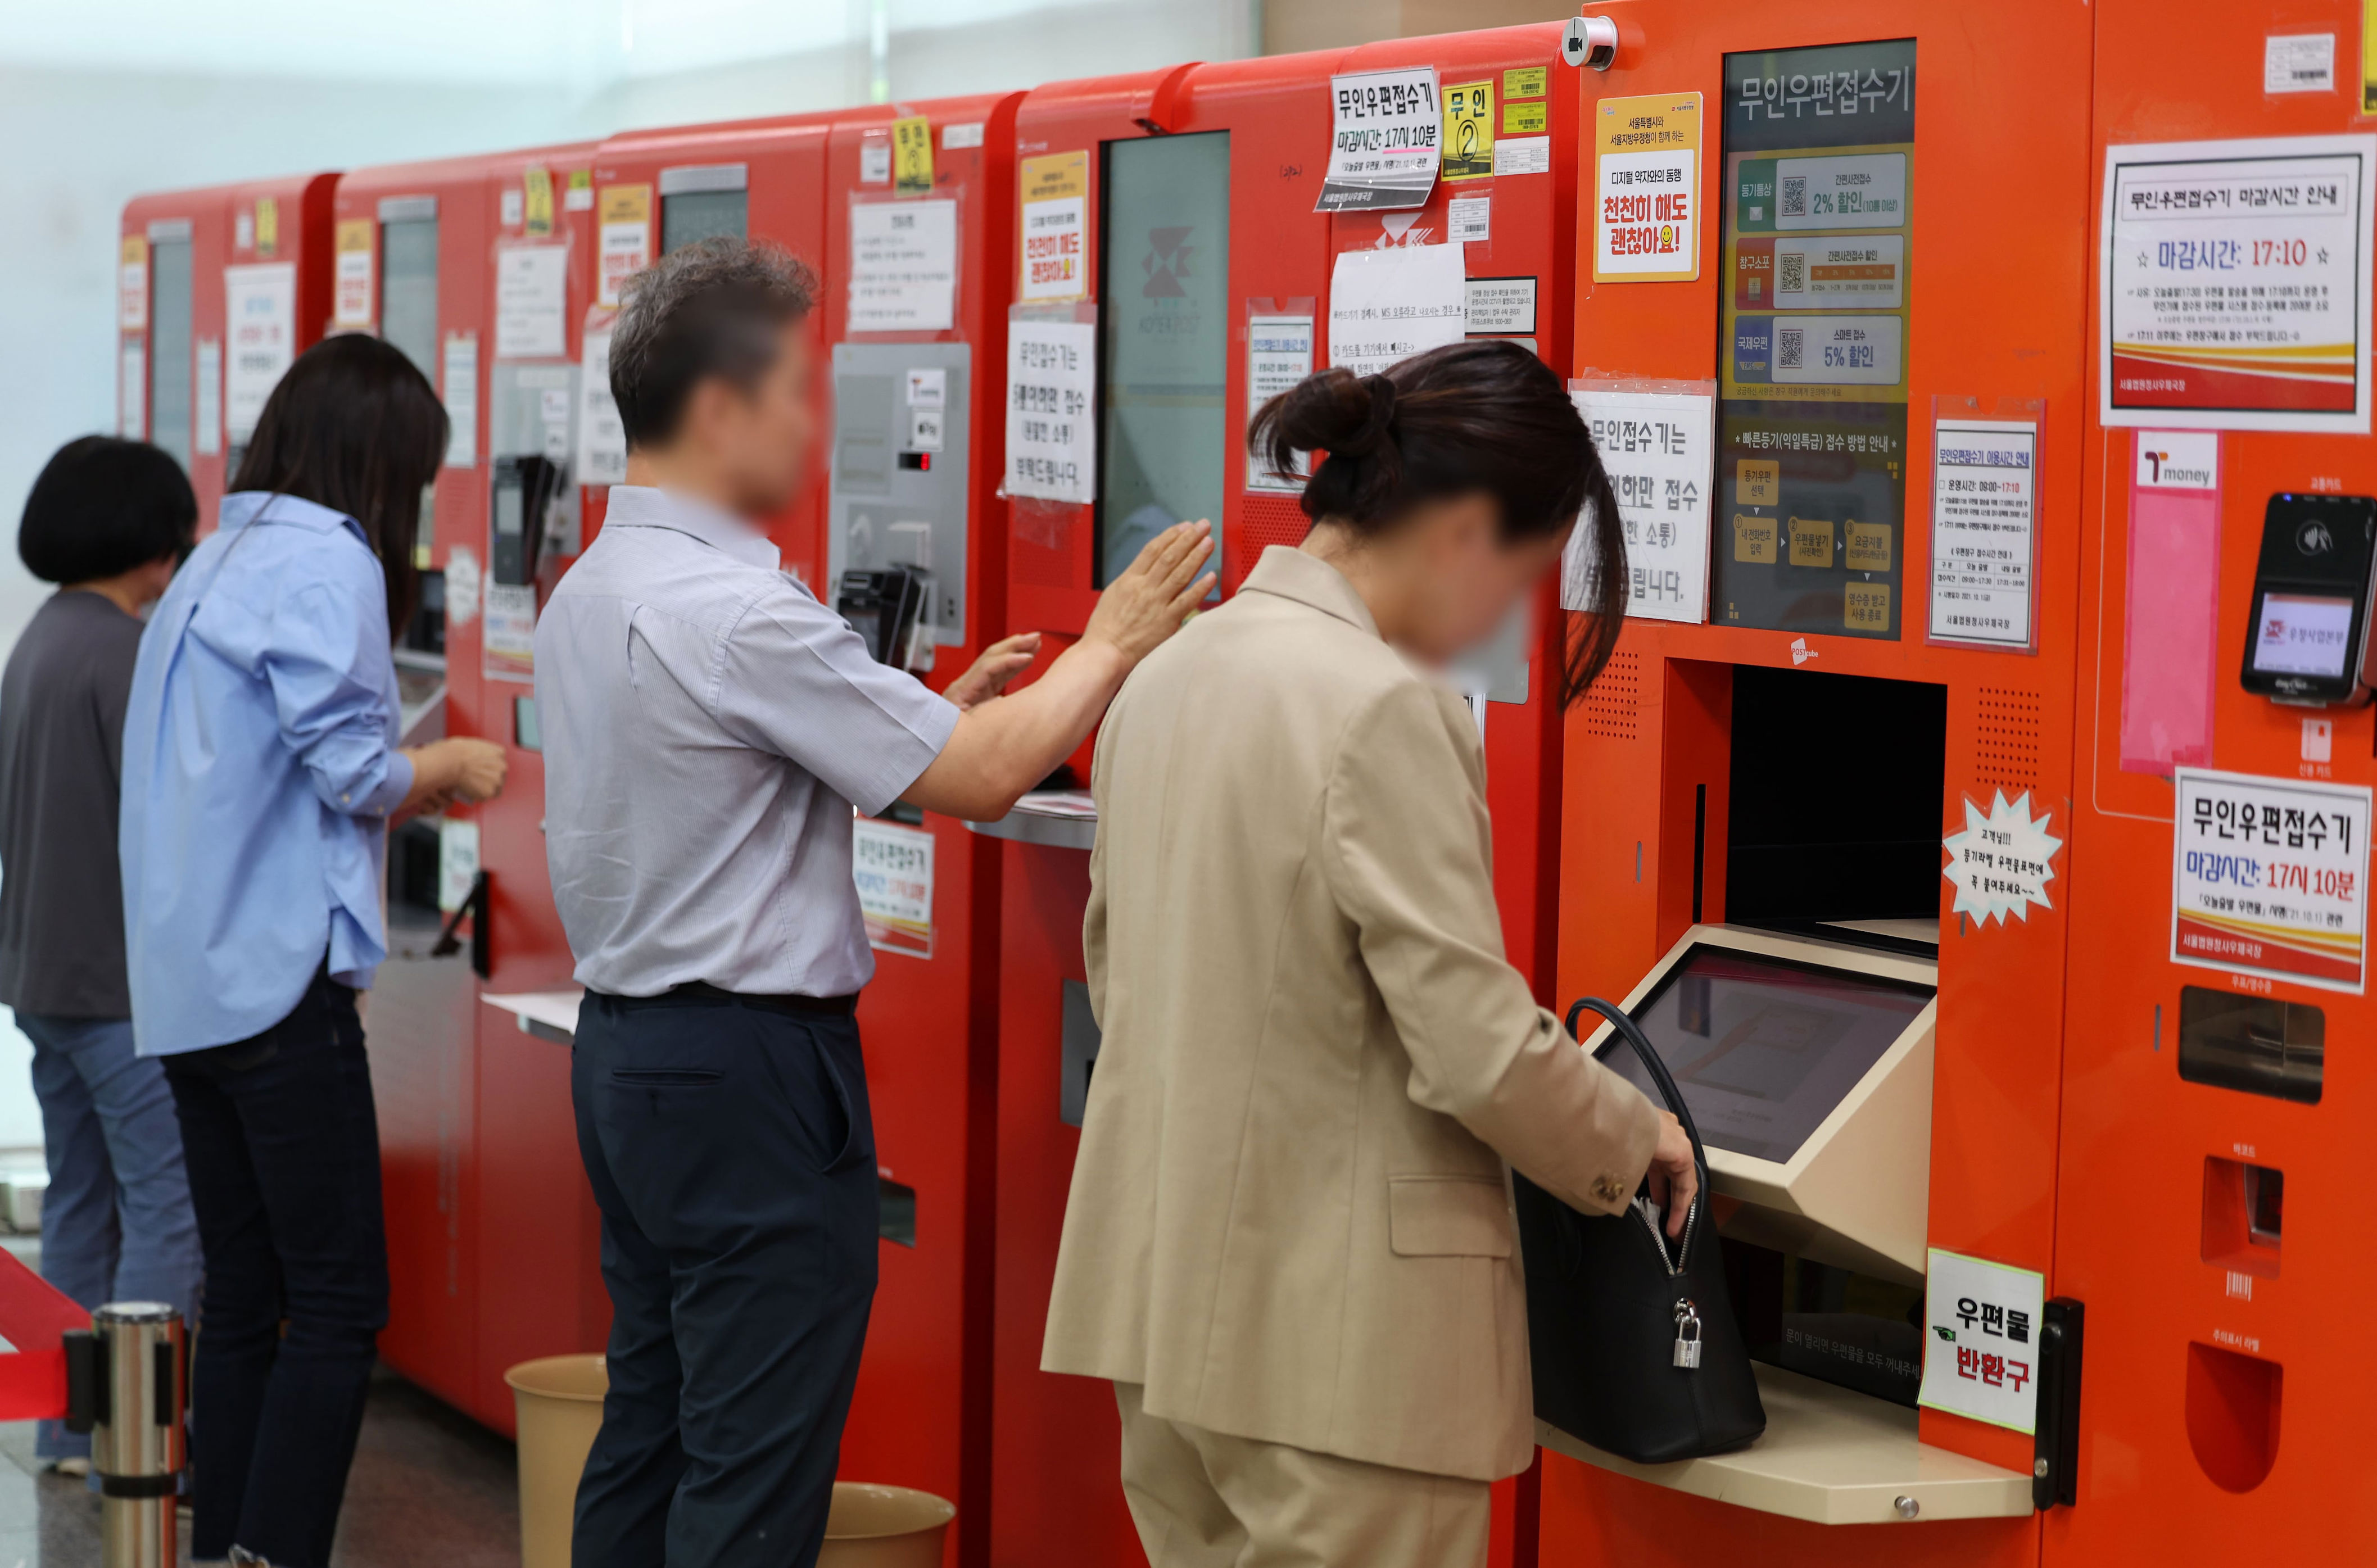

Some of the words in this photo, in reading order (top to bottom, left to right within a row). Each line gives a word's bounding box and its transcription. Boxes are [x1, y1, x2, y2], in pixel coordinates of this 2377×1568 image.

[1339, 83, 1433, 119] 무인우편접수기
[1739, 66, 1909, 120] 무인우편접수기
[1629, 116, 1664, 129] 서울특별시와
[1338, 129, 1381, 152] 마감시간:
[1385, 127, 1409, 148] 17시
[1411, 124, 1436, 147] 10분
[1611, 132, 1656, 146] 서울지방우정청이
[1659, 131, 1670, 143] 함께
[1672, 130, 1684, 142] 하는
[1611, 171, 1633, 184] 디지털
[1635, 170, 1664, 183] 약자와의
[1667, 169, 1681, 182] 동행
[1836, 174, 1871, 185] 간편사전접수
[1741, 183, 1771, 197] 등기통상
[2131, 188, 2230, 210] 무인우편접수기
[2239, 185, 2298, 207] 마감시간
[2307, 184, 2338, 205] 안내
[1604, 194, 1651, 223] 천천히
[1655, 193, 1687, 221] 해도
[1813, 193, 1833, 214] 2%
[1611, 225, 1679, 255] 괜찮아요!
[1828, 251, 1864, 262] 간편사전접수
[2158, 238, 2242, 270] 마감시간:
[2252, 239, 2307, 268] 17:10
[1740, 256, 1769, 269] 창구소포
[1382, 308, 1391, 317] MS
[1442, 305, 1454, 316] 경우
[1833, 330, 1851, 341] 스마트
[1854, 329, 1866, 341] 접수
[1738, 337, 1767, 350] 국제우편
[1824, 346, 1845, 367] 5%
[1849, 346, 1873, 368] 할인
[1592, 419, 1686, 455] 무인접수기는
[1742, 432, 1823, 450] 빠른등기(익일특급)
[1826, 433, 1845, 450] 접수
[1848, 434, 1866, 452] 방법
[1869, 435, 1888, 453] 안내
[1940, 449, 1984, 464] 무인우편접수기
[1987, 451, 2013, 465] 이용시간
[2016, 452, 2030, 466] 안내
[1745, 470, 1771, 483] 등기우편
[2164, 468, 2210, 486] money
[1751, 485, 1764, 497] 선택
[1948, 480, 1976, 492] 운영시간:
[1665, 478, 1698, 511] 접수
[1646, 521, 1676, 549] 소통)
[1749, 529, 1771, 541] 전화번호
[1795, 533, 1828, 548] 우편물넣기
[1855, 536, 1883, 549] 요금지불
[1750, 543, 1762, 555] 입력
[1849, 593, 1871, 606] 영수증
[1872, 594, 1885, 607] 받고
[1851, 608, 1866, 621] 사용
[1868, 610, 1881, 621] 종료
[1946, 614, 2010, 629] 서울법원청사우체국장
[1792, 647, 1818, 658] POSTcube
[2194, 797, 2350, 855] 무인우편접수기
[1981, 829, 2011, 845] 고객님!!!
[1964, 848, 1993, 868] 등기라벨
[1998, 856, 2044, 876] 우편물표면에
[1971, 874, 1977, 890] 꼭
[2186, 851, 2261, 887] 마감시간:
[2267, 863, 2308, 895] 17시
[2313, 869, 2354, 901] 10분
[2233, 1143, 2256, 1158] 바코드
[1956, 1297, 2029, 1344] 우편물
[1786, 1328, 1802, 1346] 문이
[1805, 1334, 1828, 1353] 열리면
[1831, 1342, 1864, 1364] 우편물을
[1867, 1352, 1884, 1368] 모두
[1885, 1357, 1921, 1380] 꺼내주세
[1957, 1345, 2029, 1393] 반환구
